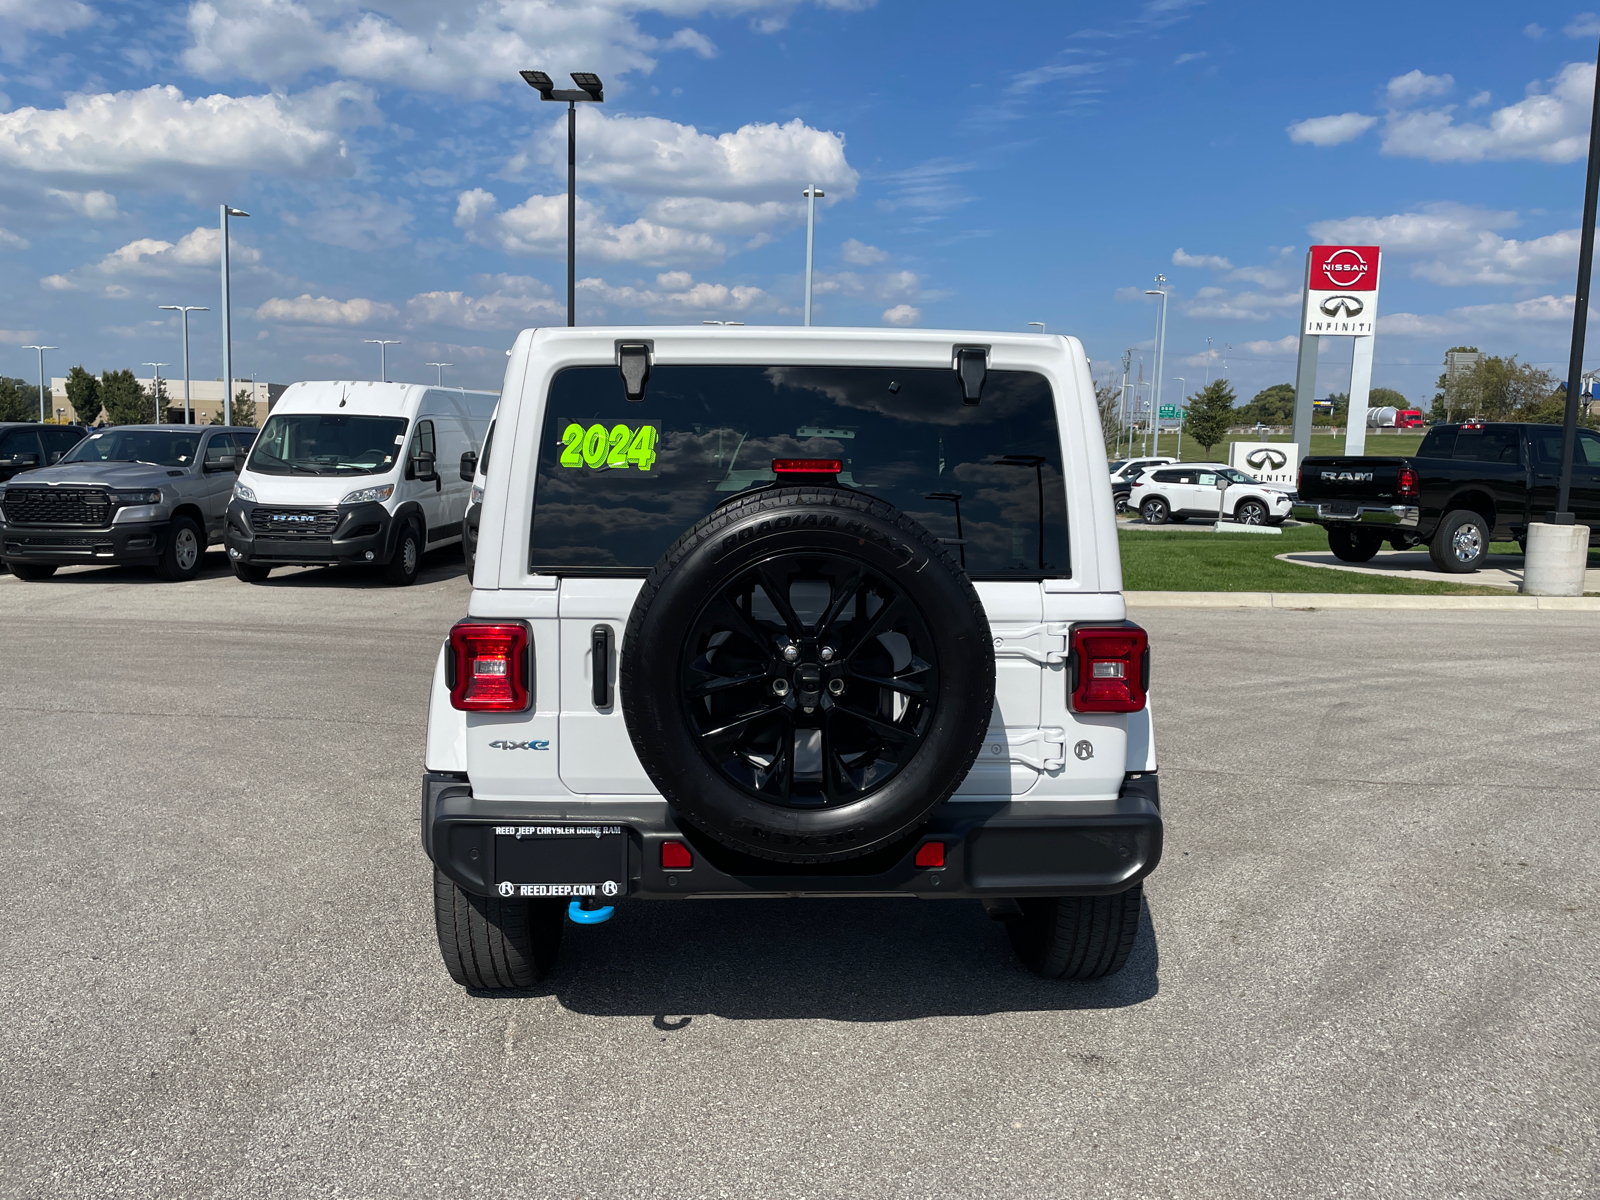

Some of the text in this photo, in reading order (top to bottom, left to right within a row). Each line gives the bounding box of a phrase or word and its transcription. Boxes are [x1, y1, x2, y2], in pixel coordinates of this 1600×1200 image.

[1309, 322, 1371, 332] INFINITI
[560, 423, 657, 471] 2024
[1252, 474, 1292, 482] FINITI
[1320, 471, 1373, 482] RAM
[272, 514, 315, 522] RAM
[721, 515, 838, 550] ROADIAN
[495, 826, 621, 835] REED JEEP CHRYSLER DODGE RAM
[751, 826, 856, 847] NEXEN
[520, 885, 596, 896] REEDJEEP.COM
